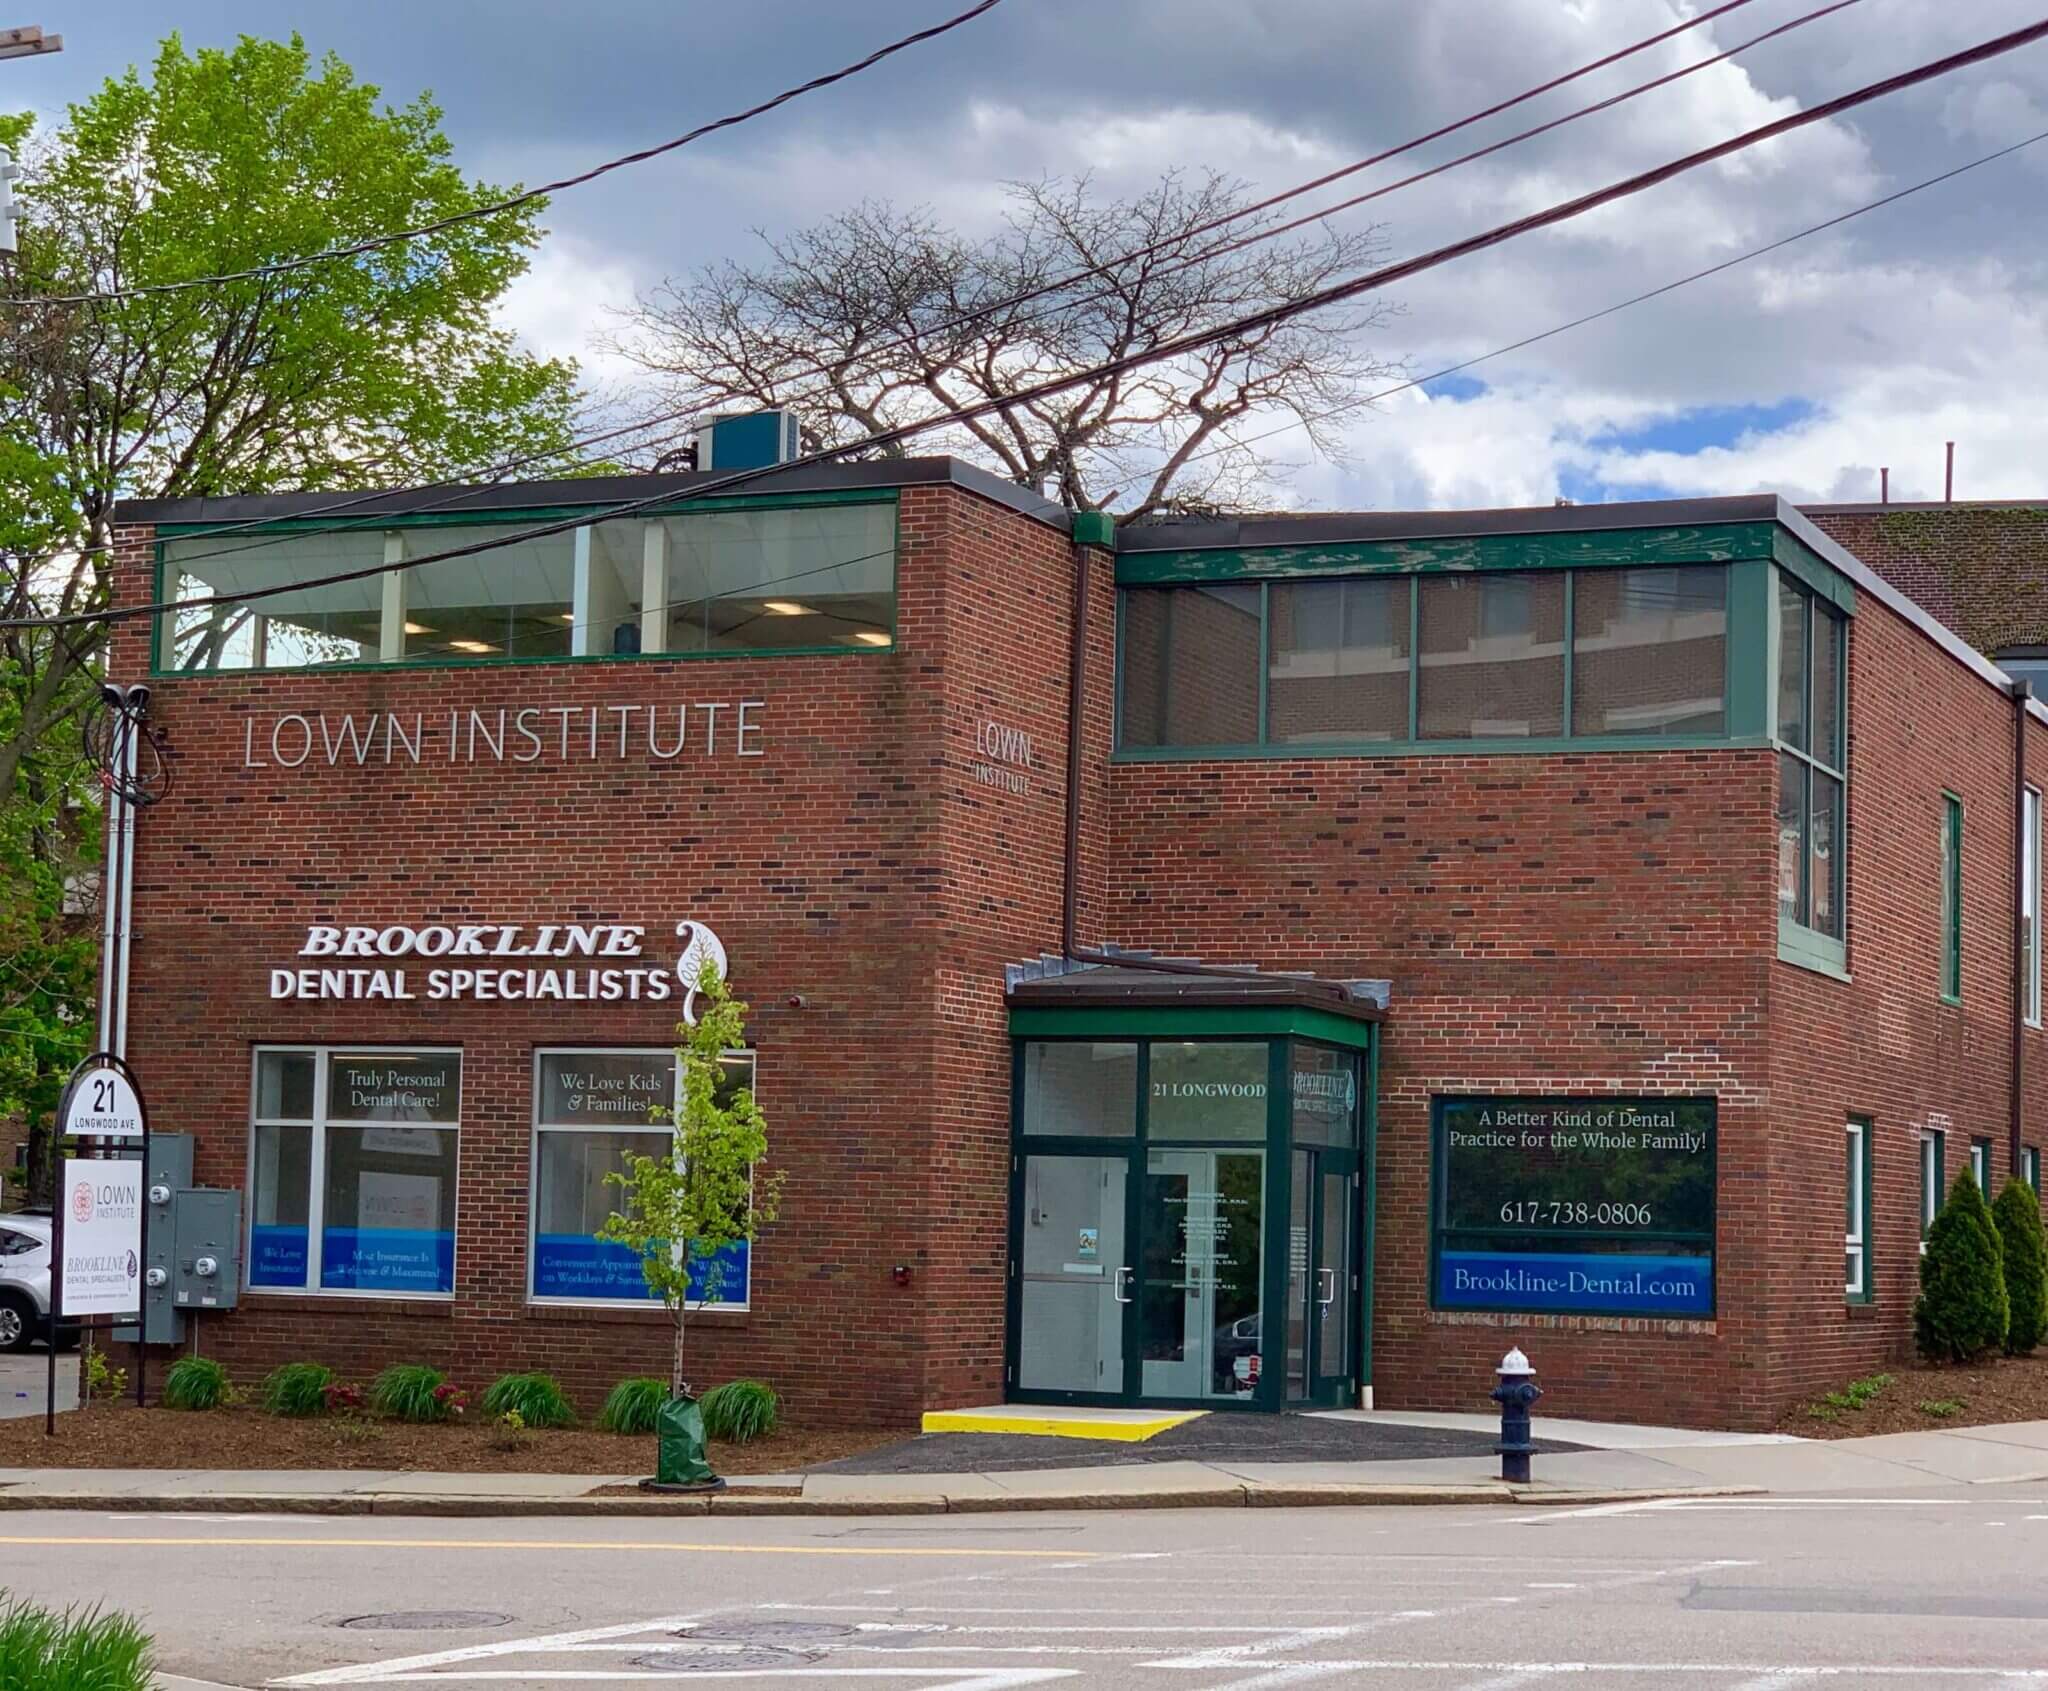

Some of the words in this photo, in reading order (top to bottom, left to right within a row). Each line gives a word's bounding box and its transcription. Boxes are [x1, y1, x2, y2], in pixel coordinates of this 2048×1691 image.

[244, 712, 422, 767] LOWN
[451, 701, 766, 763] INSTITUTE
[976, 720, 1032, 768] LOWN
[975, 763, 1031, 796] INSTITUTE
[297, 924, 646, 958] BROOKLINE
[270, 968, 416, 1000] DENTAL
[427, 968, 671, 1000] SPECIALISTS
[347, 1070, 384, 1090] Truly
[387, 1070, 446, 1087] Personal
[560, 1073, 585, 1090] We
[589, 1073, 625, 1090] Love
[629, 1073, 662, 1091] Kids
[1152, 1083, 1167, 1097] 21
[1172, 1083, 1267, 1097] LONGWOOD
[93, 1079, 115, 1113] 21
[352, 1090, 398, 1107] Dental
[401, 1091, 441, 1108] Care!
[568, 1094, 583, 1111] &
[586, 1094, 651, 1112] Families!
[74, 1117, 119, 1129] LONGWOOD
[120, 1119, 135, 1130] AVE
[1479, 1110, 1493, 1126] A
[1496, 1111, 1548, 1127] Better
[1552, 1111, 1592, 1127] Kind
[1597, 1111, 1615, 1127] of
[1619, 1111, 1675, 1128] Dental
[1449, 1131, 1516, 1147] Practice
[1521, 1131, 1546, 1148] for
[1550, 1131, 1578, 1148] the
[1582, 1132, 1637, 1149] Whole
[1642, 1132, 1707, 1153] Family!
[97, 1185, 136, 1205] LOWN
[96, 1207, 135, 1219] INSTITUTE
[1500, 1201, 1651, 1225] 617-738-0806
[67, 1256, 126, 1273] BROOKLINE
[66, 1276, 89, 1285] DENTAL
[1454, 1268, 1697, 1297] Brookline-Dental.com
